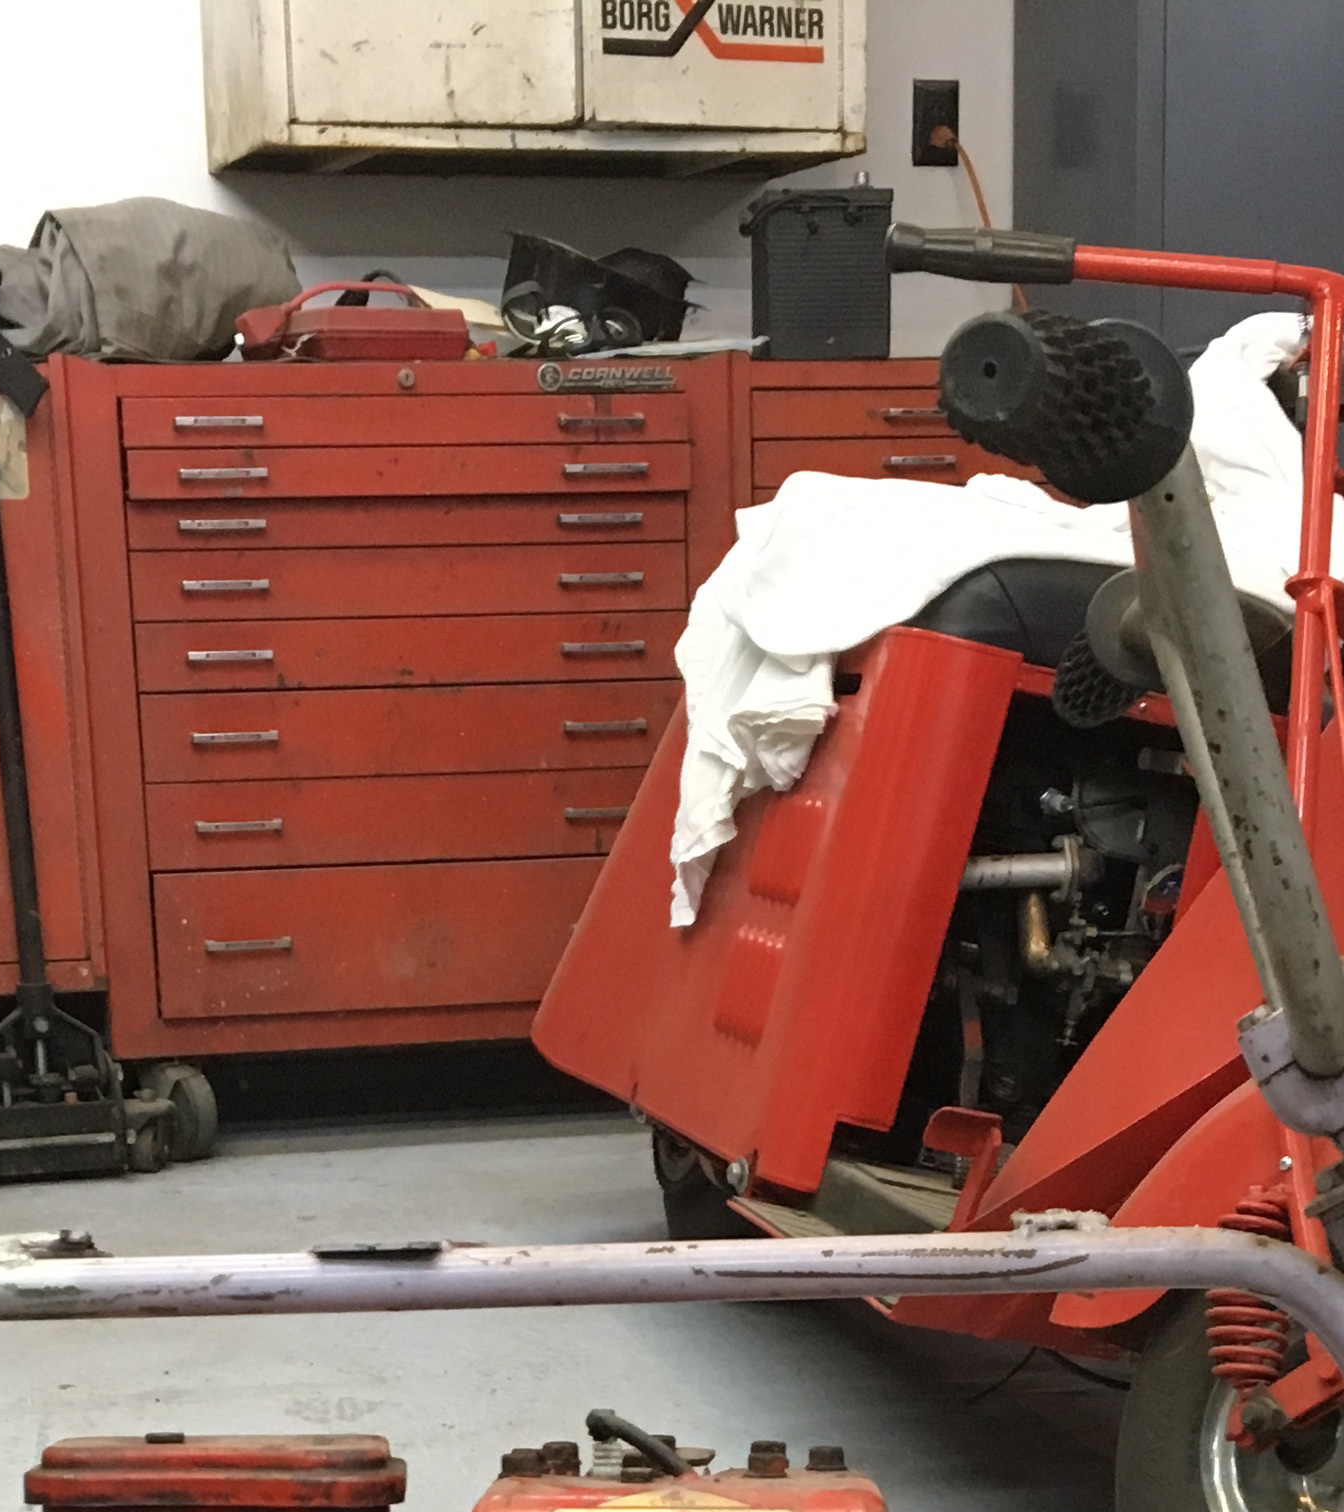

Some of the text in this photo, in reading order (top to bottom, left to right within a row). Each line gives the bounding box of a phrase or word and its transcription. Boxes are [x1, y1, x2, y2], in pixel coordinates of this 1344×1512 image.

[601, 0, 824, 39] BORG WARNER
[568, 366, 674, 380] CORNWELL
